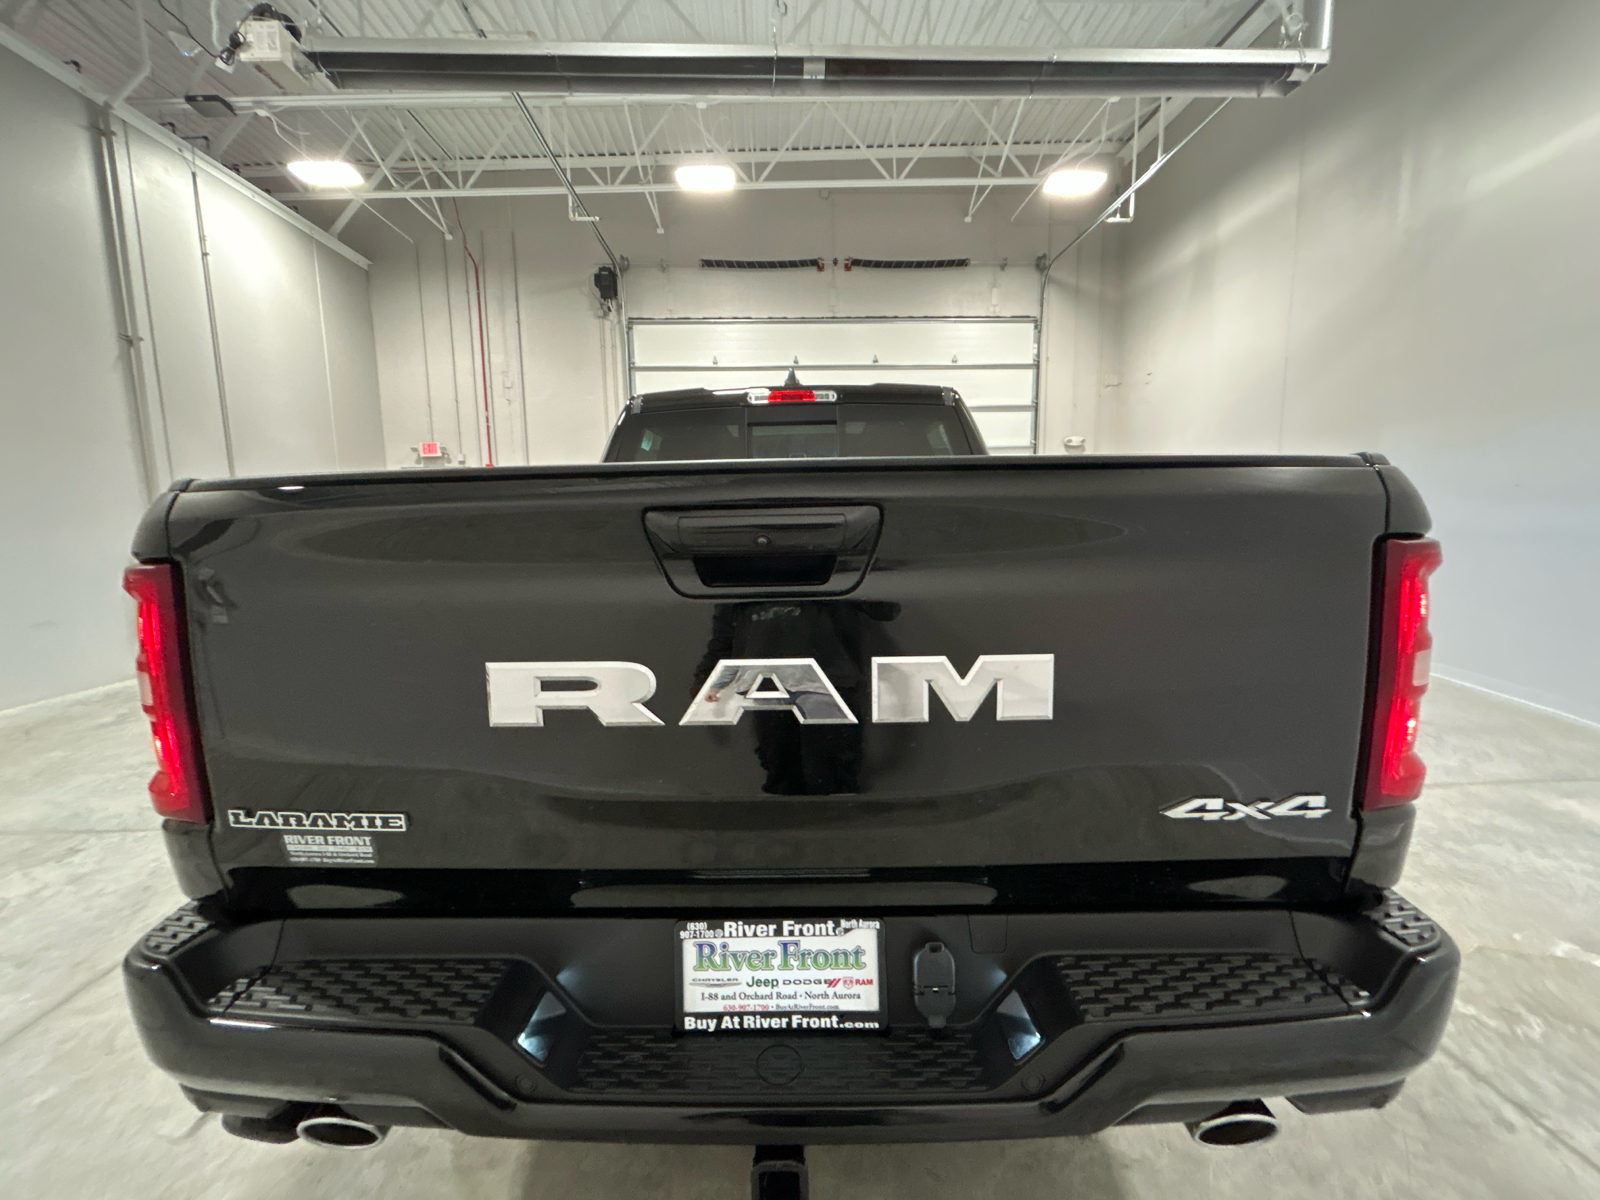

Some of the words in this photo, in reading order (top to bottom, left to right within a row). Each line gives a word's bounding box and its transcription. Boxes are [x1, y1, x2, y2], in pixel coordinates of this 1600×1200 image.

[485, 653, 1055, 728] RAM
[227, 809, 407, 831] LARAMIE
[283, 835, 325, 845] RIVER
[326, 836, 371, 846] FRONT
[686, 922, 708, 931] (630)
[723, 921, 777, 937] River
[782, 920, 836, 936] Front
[680, 930, 714, 939] 907-1700
[693, 941, 777, 971] River
[778, 940, 866, 971] Front
[746, 976, 779, 989] Jeep
[701, 992, 719, 1001] I-88
[720, 992, 737, 1001] and
[738, 991, 774, 1001] Orchard
[775, 991, 798, 1000] Road
[804, 990, 830, 1000] North
[831, 991, 861, 1000] Aurora
[722, 1003, 770, 1012] 630-907-1700
[684, 1016, 717, 1033] Buy
[720, 1015, 741, 1030] At
[742, 1014, 790, 1029] River
